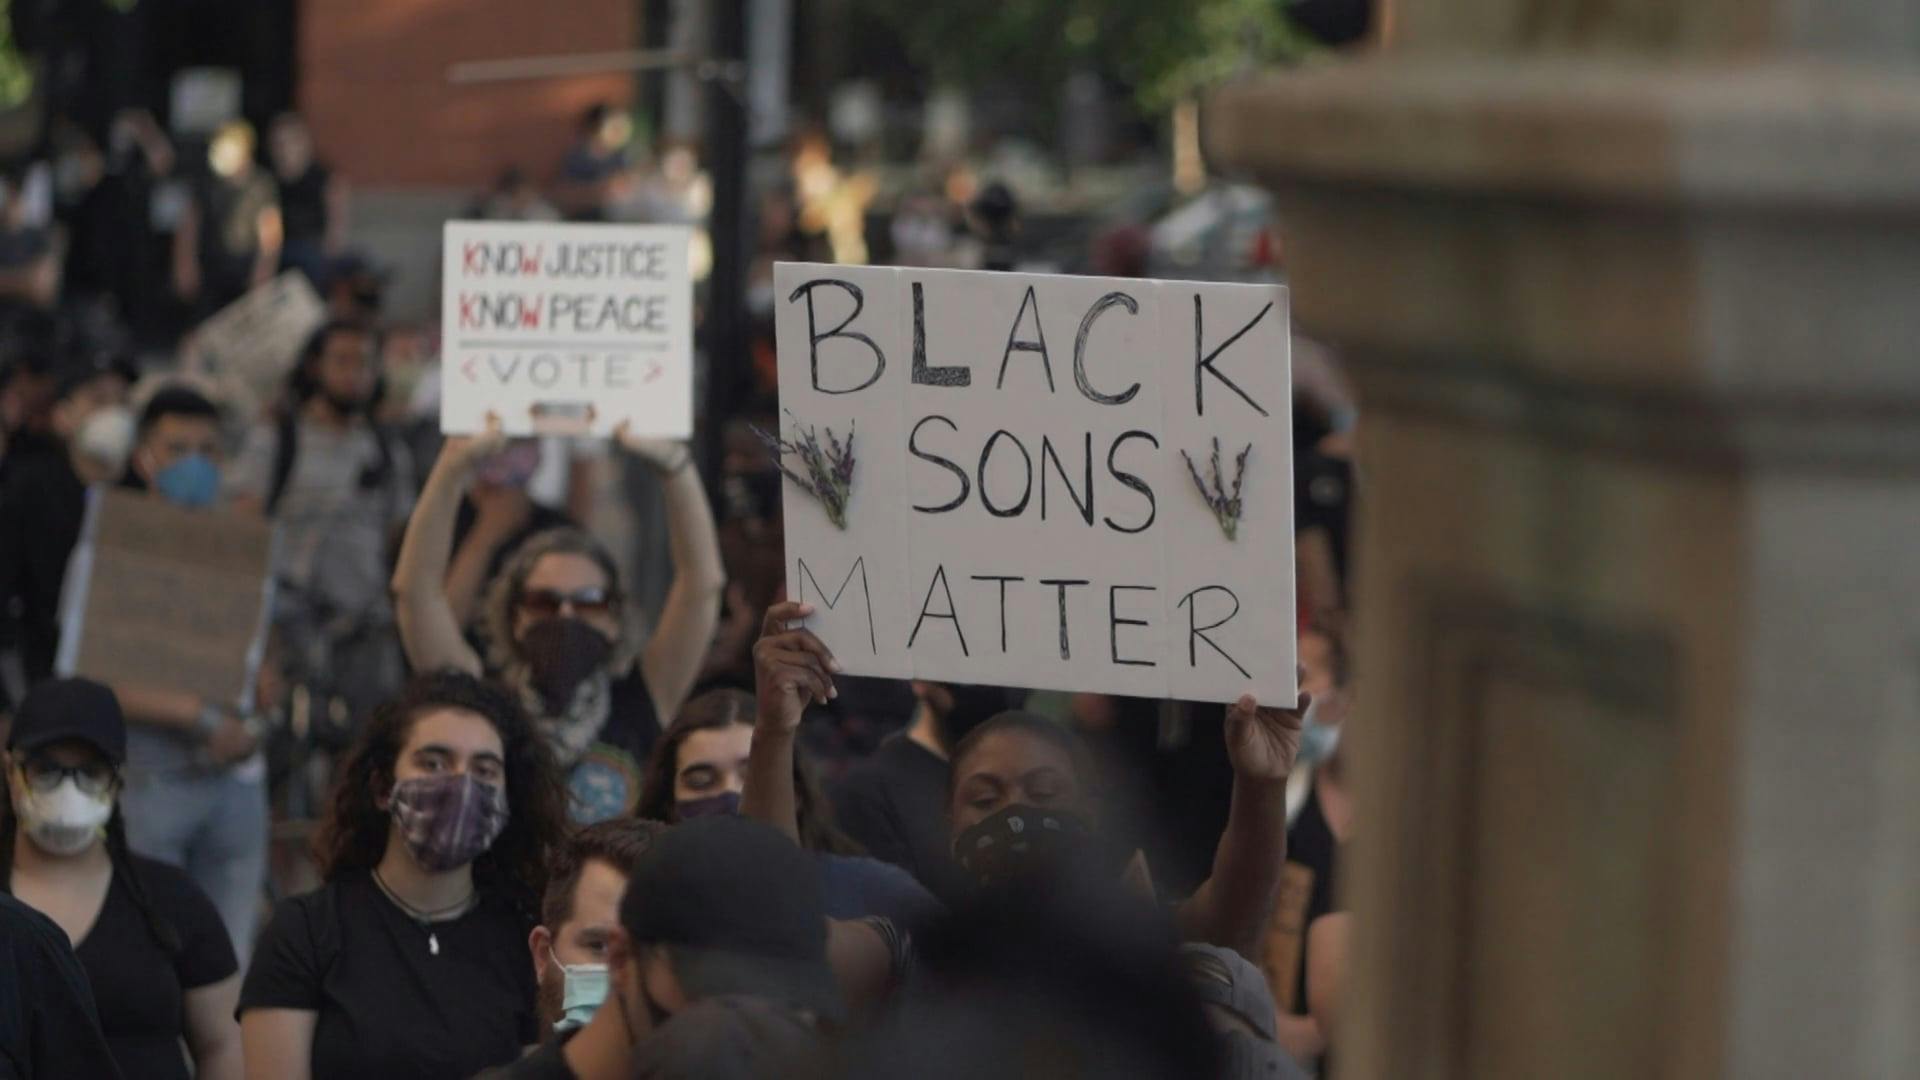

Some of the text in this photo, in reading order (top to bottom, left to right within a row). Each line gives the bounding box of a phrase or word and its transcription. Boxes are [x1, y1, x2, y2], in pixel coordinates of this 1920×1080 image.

[462, 240, 668, 279] KNOW JUSTICE
[459, 291, 668, 332] KNOW PEACE
[789, 279, 1273, 416] BLACK
[487, 353, 632, 388] VOTE
[908, 415, 1159, 533] SONS
[798, 556, 1251, 679] MATTER
